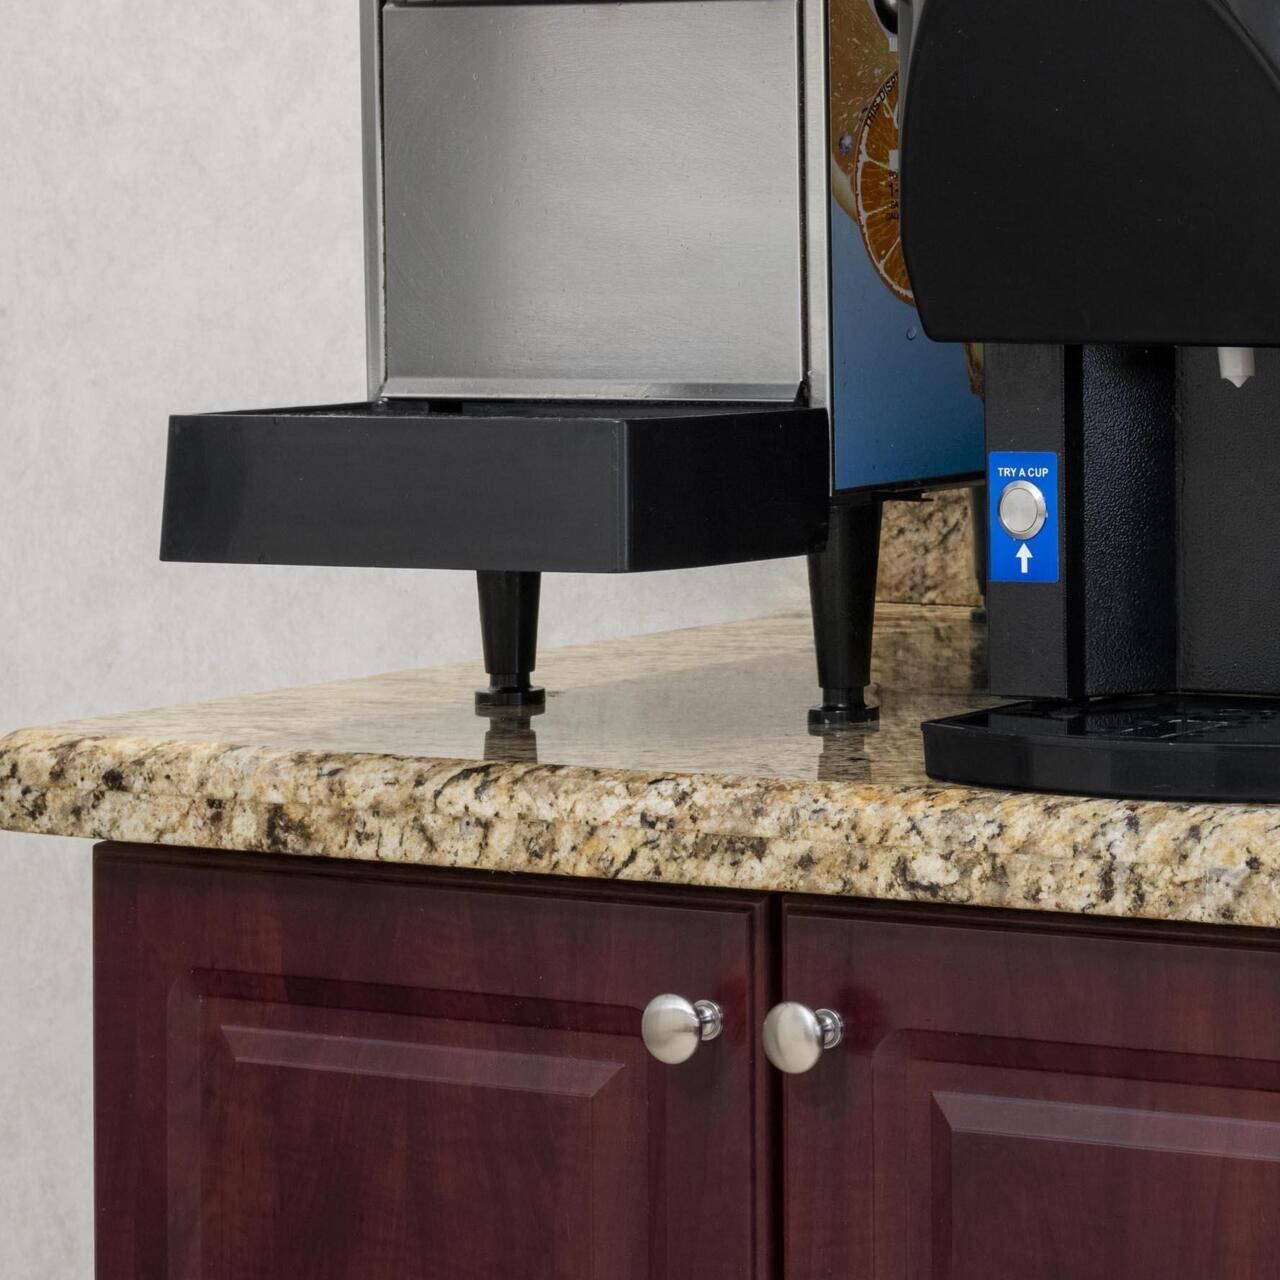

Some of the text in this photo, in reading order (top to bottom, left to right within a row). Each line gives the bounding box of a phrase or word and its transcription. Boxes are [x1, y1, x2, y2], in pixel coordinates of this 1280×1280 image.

[998, 468, 1048, 477] TRY A CUP
